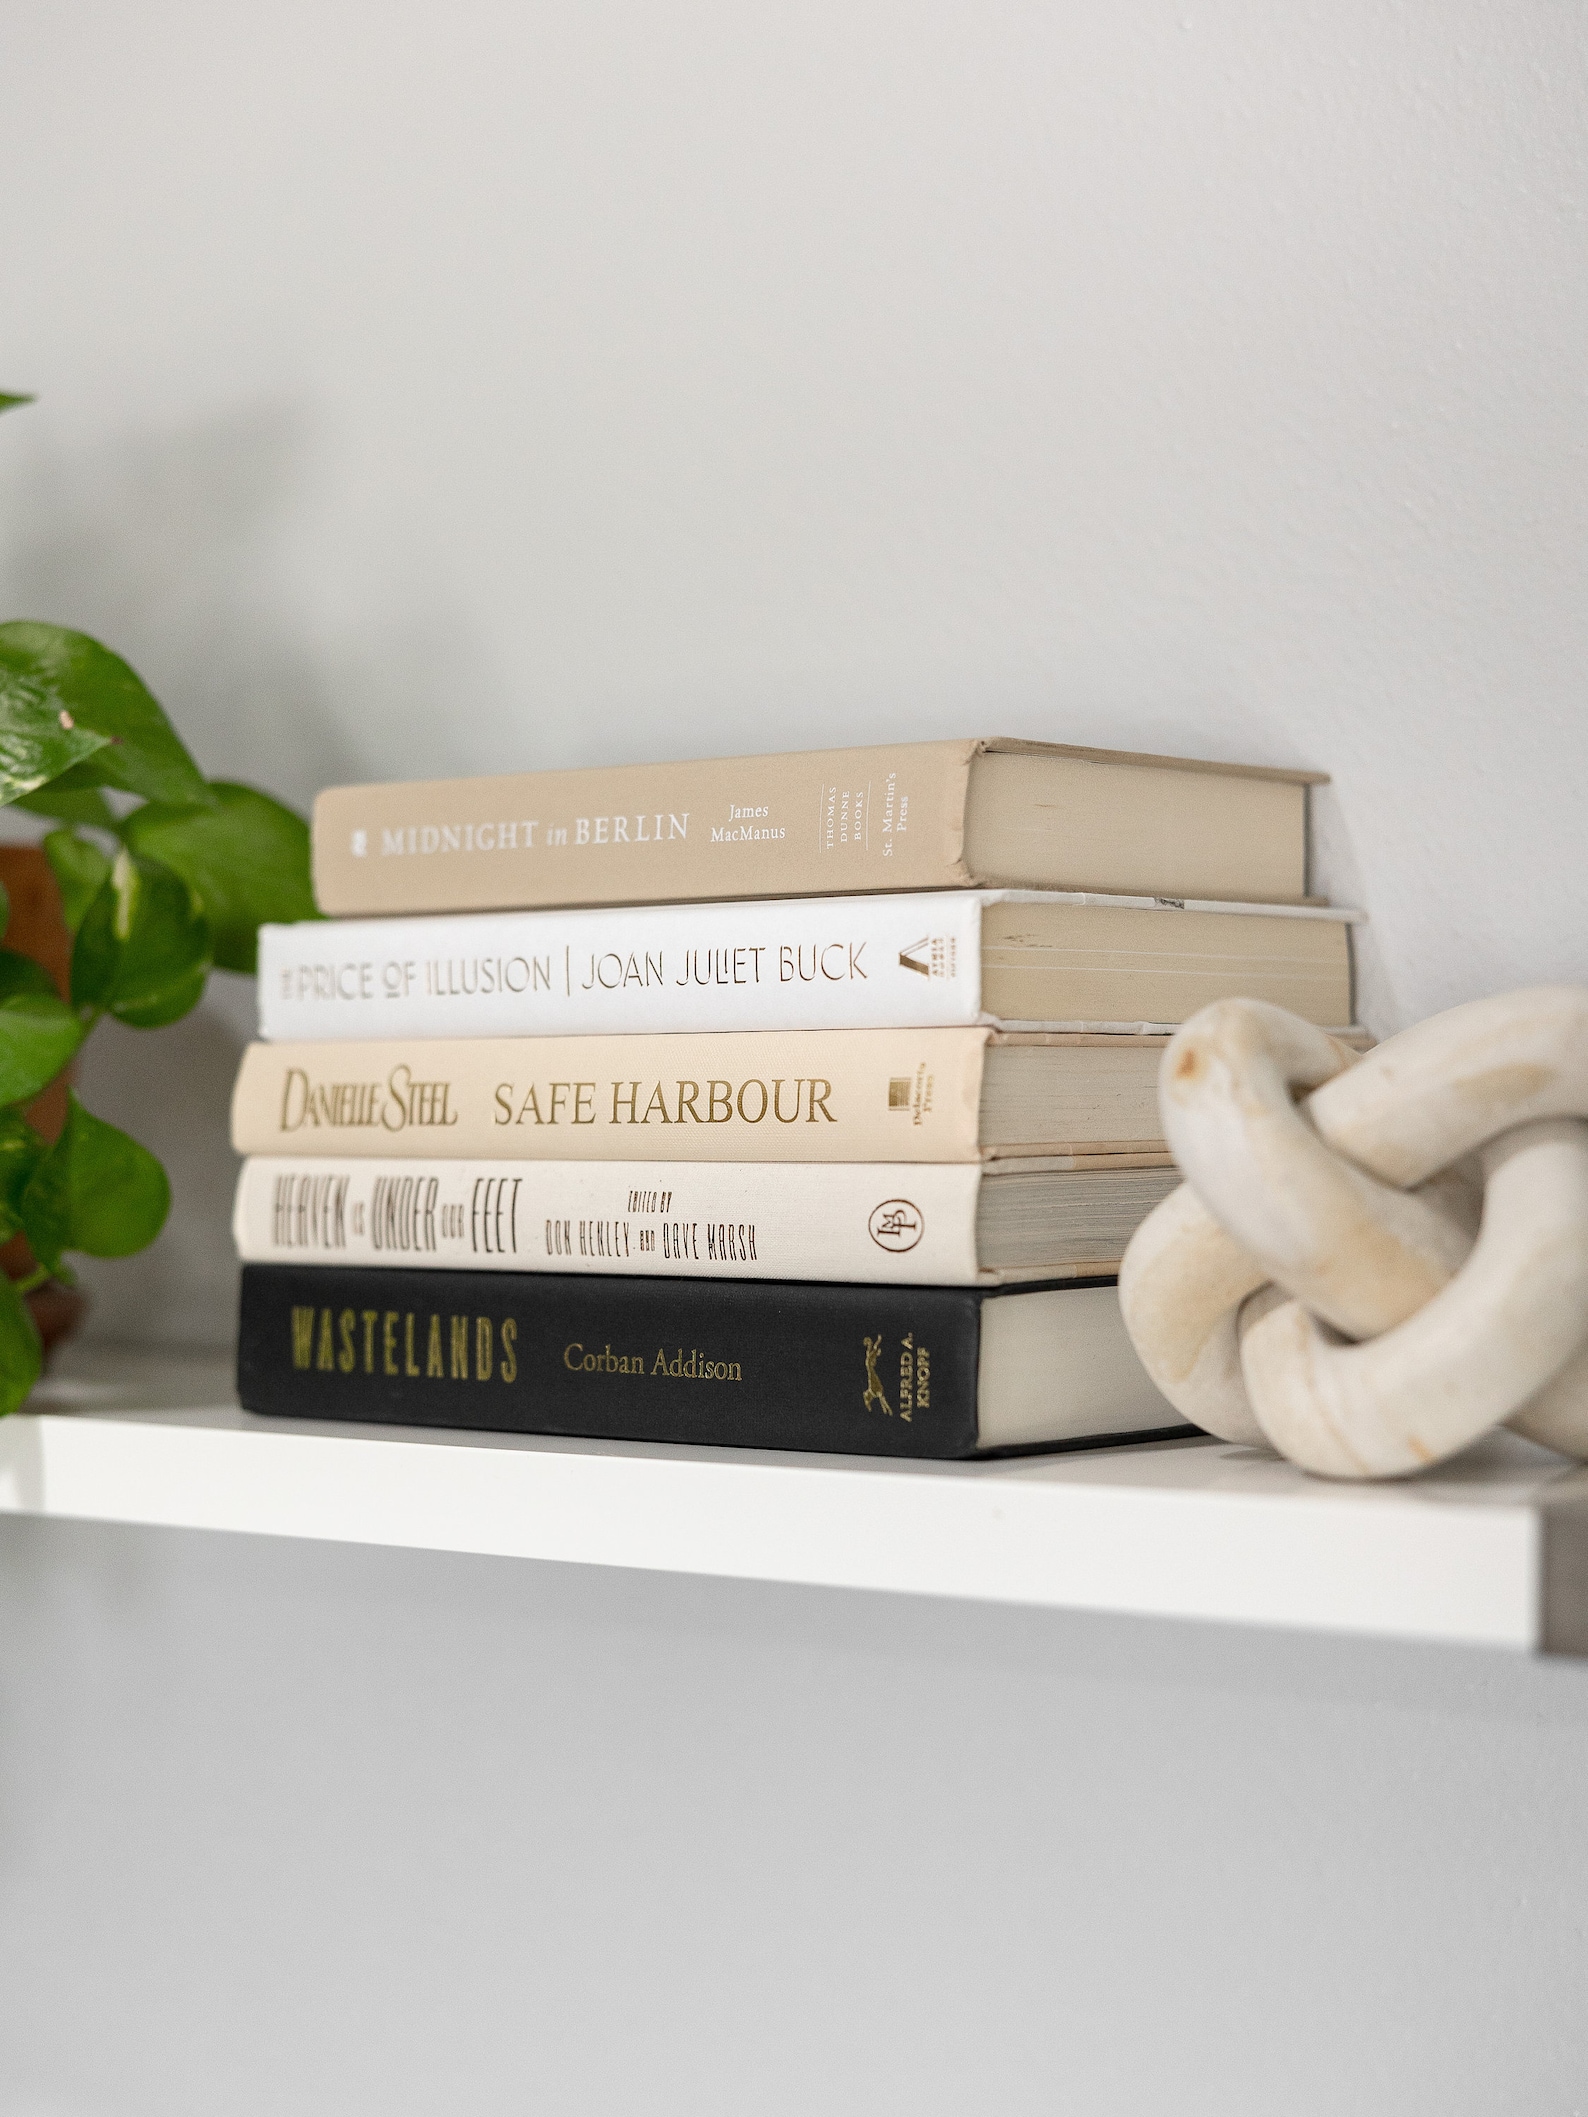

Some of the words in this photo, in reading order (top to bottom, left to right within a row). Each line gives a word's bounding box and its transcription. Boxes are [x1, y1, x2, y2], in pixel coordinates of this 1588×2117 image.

[729, 804, 769, 822] James
[826, 786, 837, 849] THOMAS
[840, 790, 850, 843] DUNNE
[854, 791, 864, 841] BOOKS
[882, 772, 897, 834] Martin's
[897, 796, 908, 832] Press
[381, 821, 538, 855] MIDNIGHT
[546, 825, 568, 846] in
[575, 813, 690, 846] BERLIN
[711, 826, 786, 843] MacManus
[883, 837, 893, 857] St.
[299, 961, 374, 1000] PRICE
[382, 960, 416, 998] OF
[425, 955, 552, 996] ILLUSION
[581, 950, 663, 990] JOAN
[676, 947, 766, 985] JULIET
[779, 941, 869, 982] BUCK
[280, 1067, 382, 1133] DANIELLE
[381, 1063, 459, 1132] STEEL
[495, 1082, 597, 1125] SAFE
[608, 1078, 838, 1124] HARBOUR
[371, 1176, 439, 1252] UNDER
[471, 1177, 523, 1254] FEET
[627, 1190, 657, 1213] EDITED
[660, 1191, 673, 1213] BY
[546, 1219, 571, 1256] DON
[579, 1219, 630, 1257] HENLEY
[663, 1222, 700, 1259] DAVE
[706, 1223, 758, 1261] MARSH
[291, 1306, 518, 1384] WASTELANDS
[563, 1342, 644, 1375] Corban
[650, 1347, 742, 1382] Addison
[900, 1331, 914, 1349] A.
[900, 1353, 913, 1422] ALFRED
[917, 1346, 930, 1408] KNOPF
